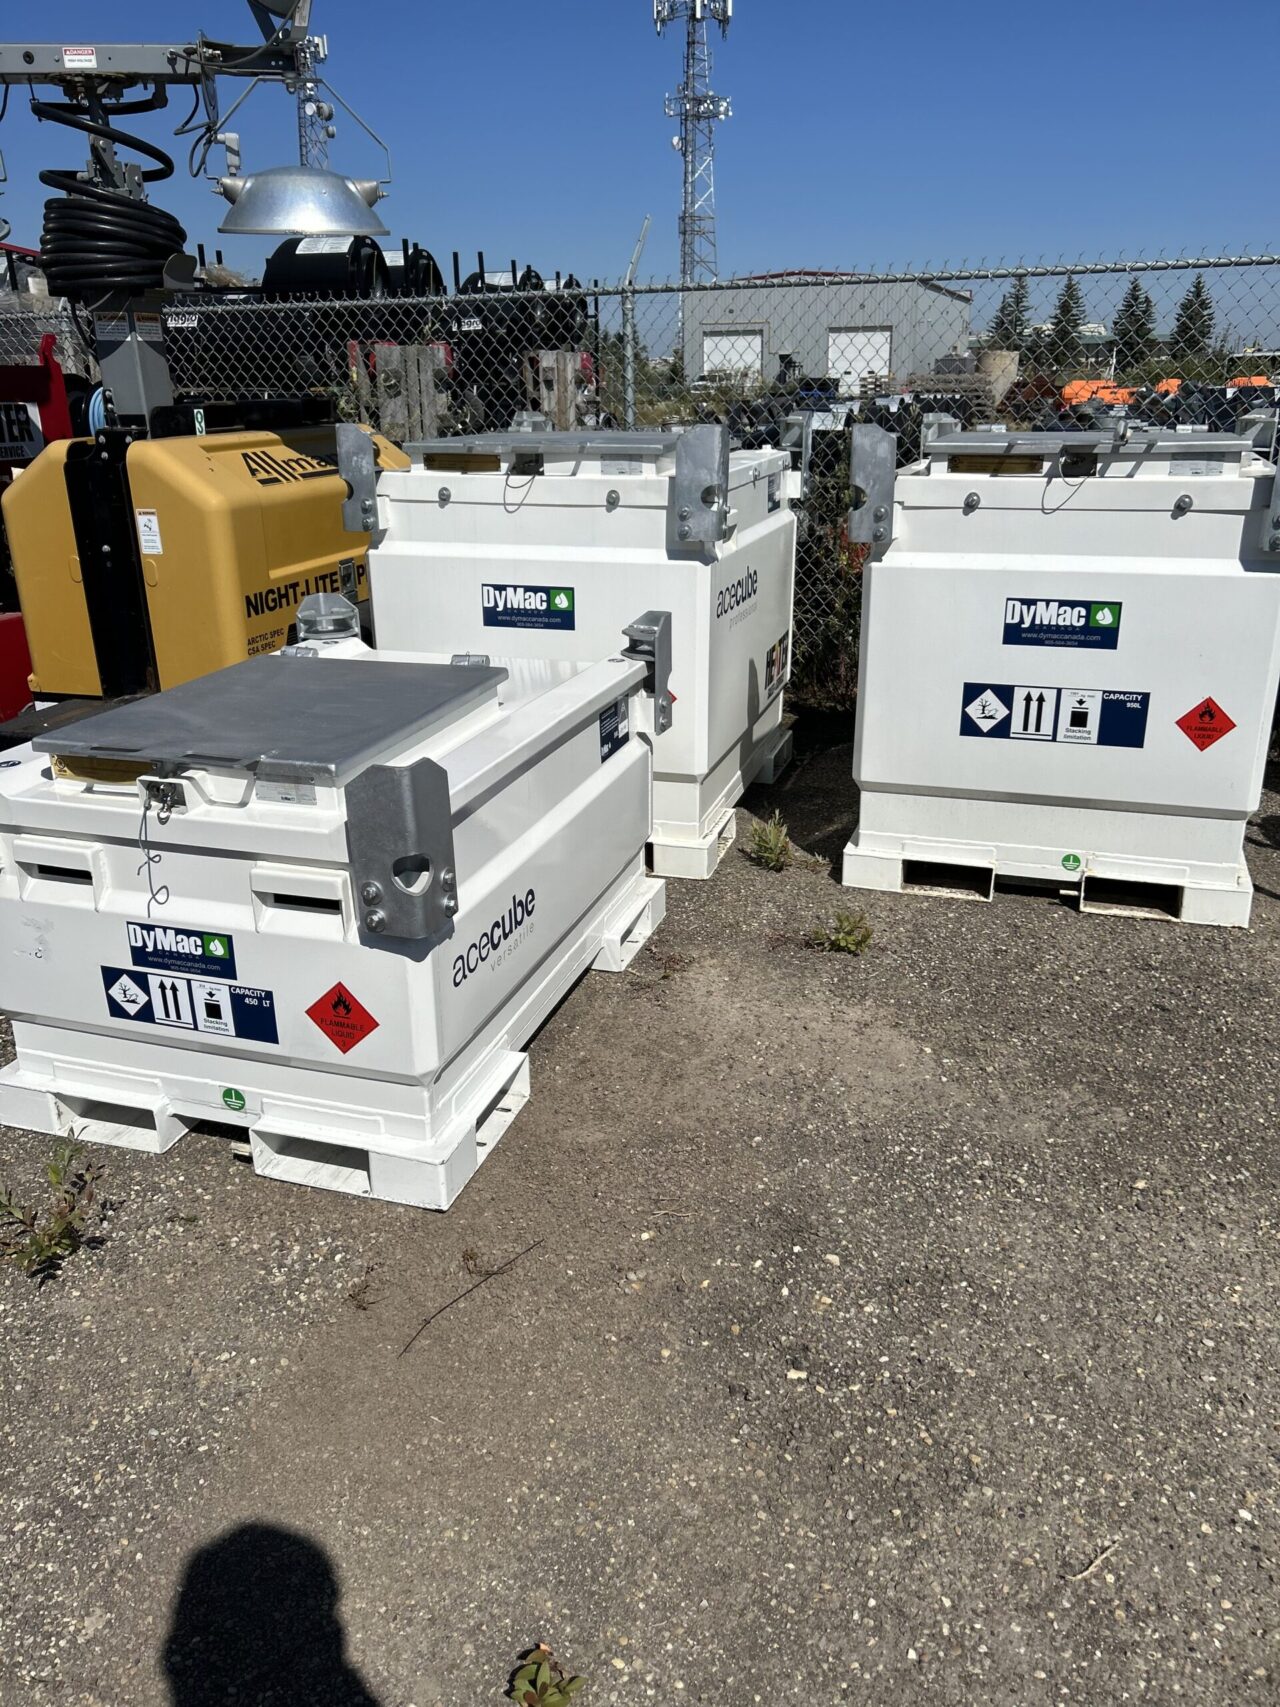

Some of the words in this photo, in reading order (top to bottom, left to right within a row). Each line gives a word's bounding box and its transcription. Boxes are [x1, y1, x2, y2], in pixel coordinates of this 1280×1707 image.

[245, 571, 340, 618] NIGHT-LITE
[356, 564, 368, 585] P
[716, 565, 758, 619] acecube
[482, 586, 547, 612] DyMac
[1005, 600, 1087, 628] DyMac
[247, 632, 268, 646] ARCTIC
[269, 628, 285, 640] SPEC
[1021, 632, 1101, 641] www.dymaccanada.com
[248, 645, 260, 656] CSA
[260, 641, 276, 652] SPEC
[1103, 693, 1143, 701] CAPACITY
[127, 924, 203, 955] DyMac
[453, 888, 535, 988] acecube
[490, 922, 535, 972] versatile
[147, 956, 221, 971] www.dymaccanada.com
[230, 986, 266, 998] CAPACITY
[244, 997, 258, 1006] 450
[203, 1018, 228, 1027] Stacking
[203, 1024, 230, 1033] limitation
[320, 1017, 365, 1032] FLAMMABLE
[331, 1029, 355, 1039] LIQUID
